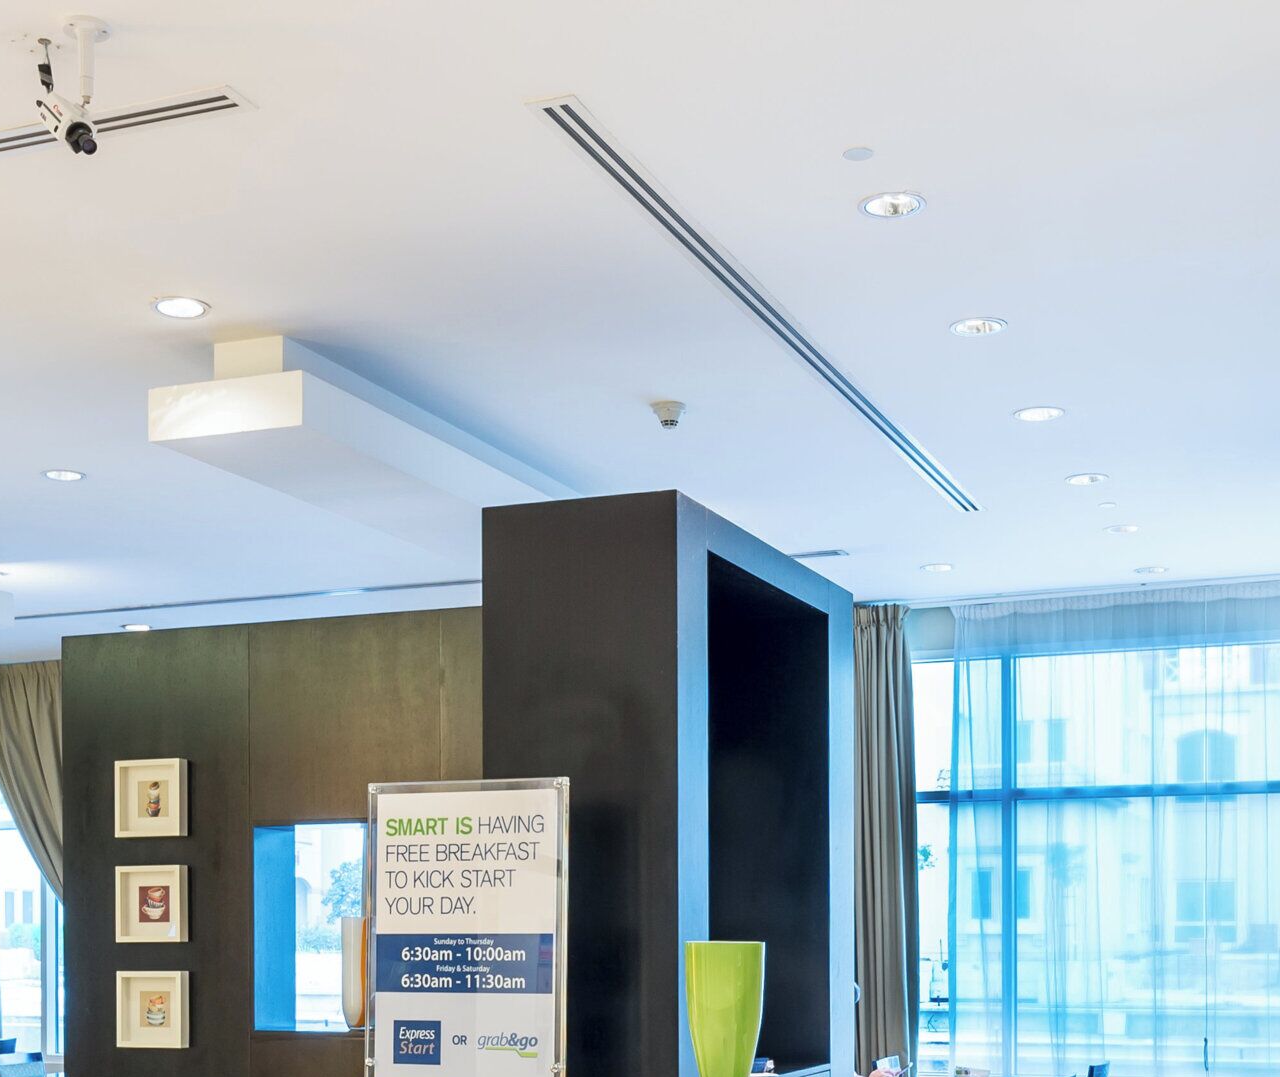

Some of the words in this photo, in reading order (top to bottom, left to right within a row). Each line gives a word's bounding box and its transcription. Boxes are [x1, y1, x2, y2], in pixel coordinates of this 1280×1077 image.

[386, 818, 448, 836] SMART
[456, 816, 472, 835] IS
[479, 814, 544, 834] HAVING
[386, 844, 430, 862] FREE
[436, 842, 540, 862] BREAKFAST
[385, 871, 407, 888] TO
[413, 870, 454, 888] KICK
[460, 869, 516, 888] START
[385, 897, 434, 915] YOUR
[441, 896, 476, 915] DAY.
[465, 938, 494, 946] Thursday
[401, 948, 452, 961] 6:30am
[466, 947, 525, 961] 10:00am
[462, 965, 490, 973] Saturday
[401, 975, 452, 988] 6:30am
[466, 975, 525, 988] 11:30am
[399, 1027, 435, 1041] Express
[452, 1035, 467, 1046] OR
[400, 1041, 435, 1055] Start
[478, 1033, 538, 1050] grab&go
